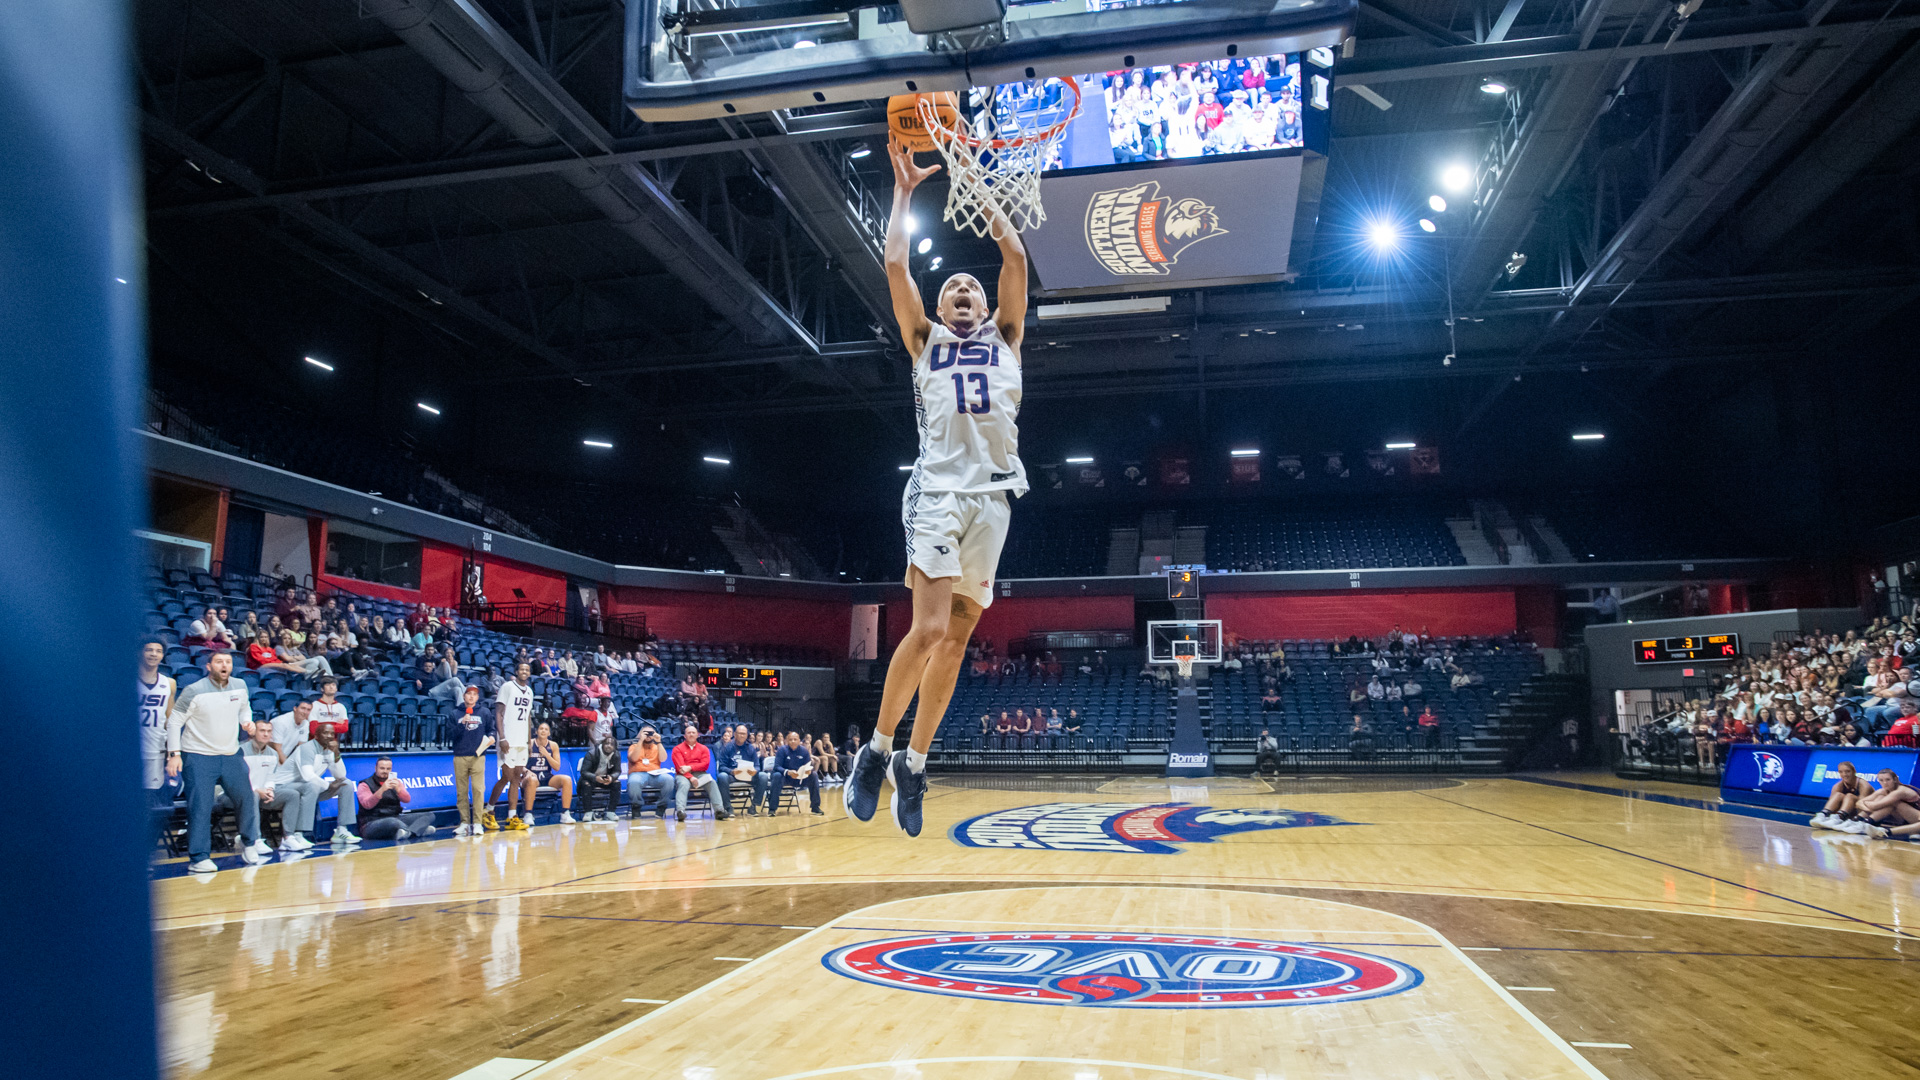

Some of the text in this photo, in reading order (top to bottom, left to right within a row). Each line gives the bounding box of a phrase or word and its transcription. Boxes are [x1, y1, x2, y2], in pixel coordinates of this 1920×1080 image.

[1091, 192, 1136, 274] SOUTHERN
[1111, 186, 1160, 274] INDIANA
[1141, 205, 1163, 261] SCREAMING EAGLES
[930, 340, 999, 372] USI
[951, 372, 991, 414] 13
[1644, 650, 1655, 660] 14
[1722, 645, 1734, 655] 15
[708, 677, 717, 685] 14
[769, 678, 778, 687] 15
[514, 697, 530, 706] USI
[141, 709, 157, 727] 21
[536, 758, 546, 766] 23
[1170, 753, 1208, 763] Romain
[401, 775, 454, 788] NAL BANK
[945, 945, 1285, 981] OVC
[851, 960, 1040, 997] VALLEY
[1199, 984, 1362, 1001] OHIO
